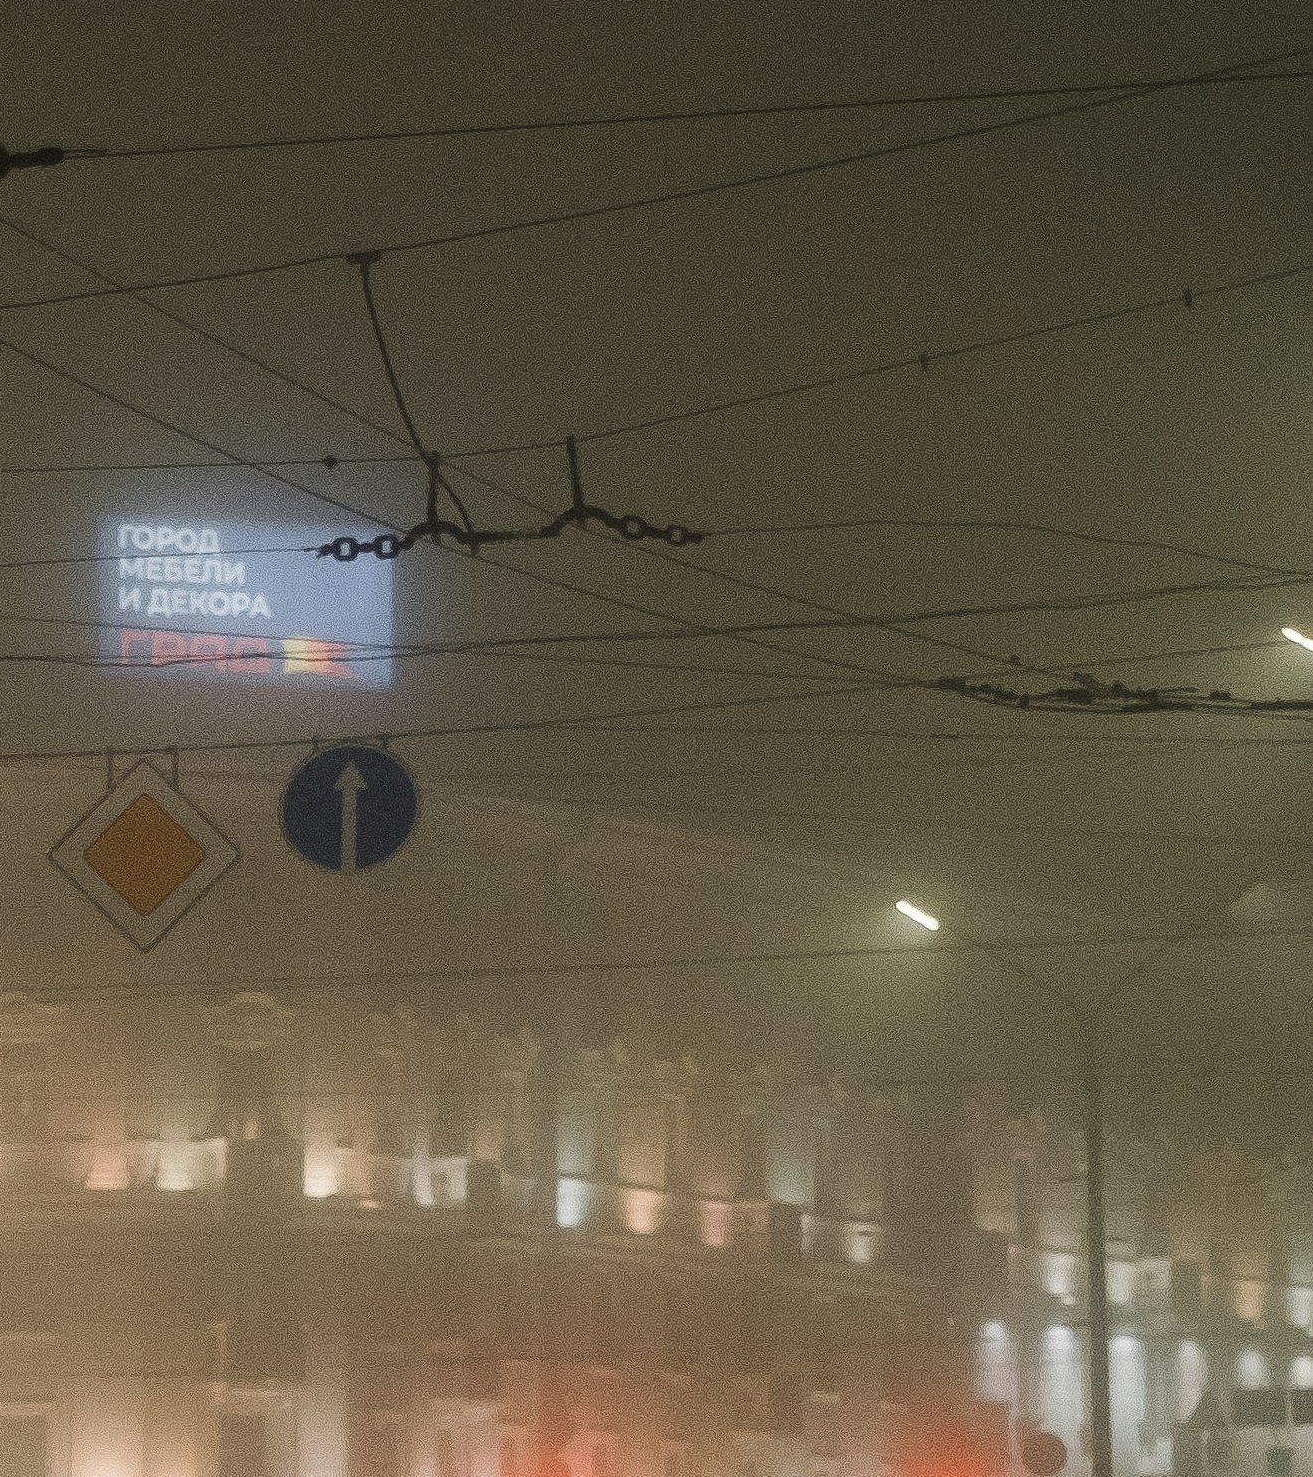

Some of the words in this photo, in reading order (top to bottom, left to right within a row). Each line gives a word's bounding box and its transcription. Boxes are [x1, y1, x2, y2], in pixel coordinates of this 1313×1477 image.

[118, 525, 221, 552] ГОРОД
[119, 557, 247, 585] МЕБЕЛИ
[118, 586, 141, 611] И
[147, 587, 271, 619] ДЕКОРА
